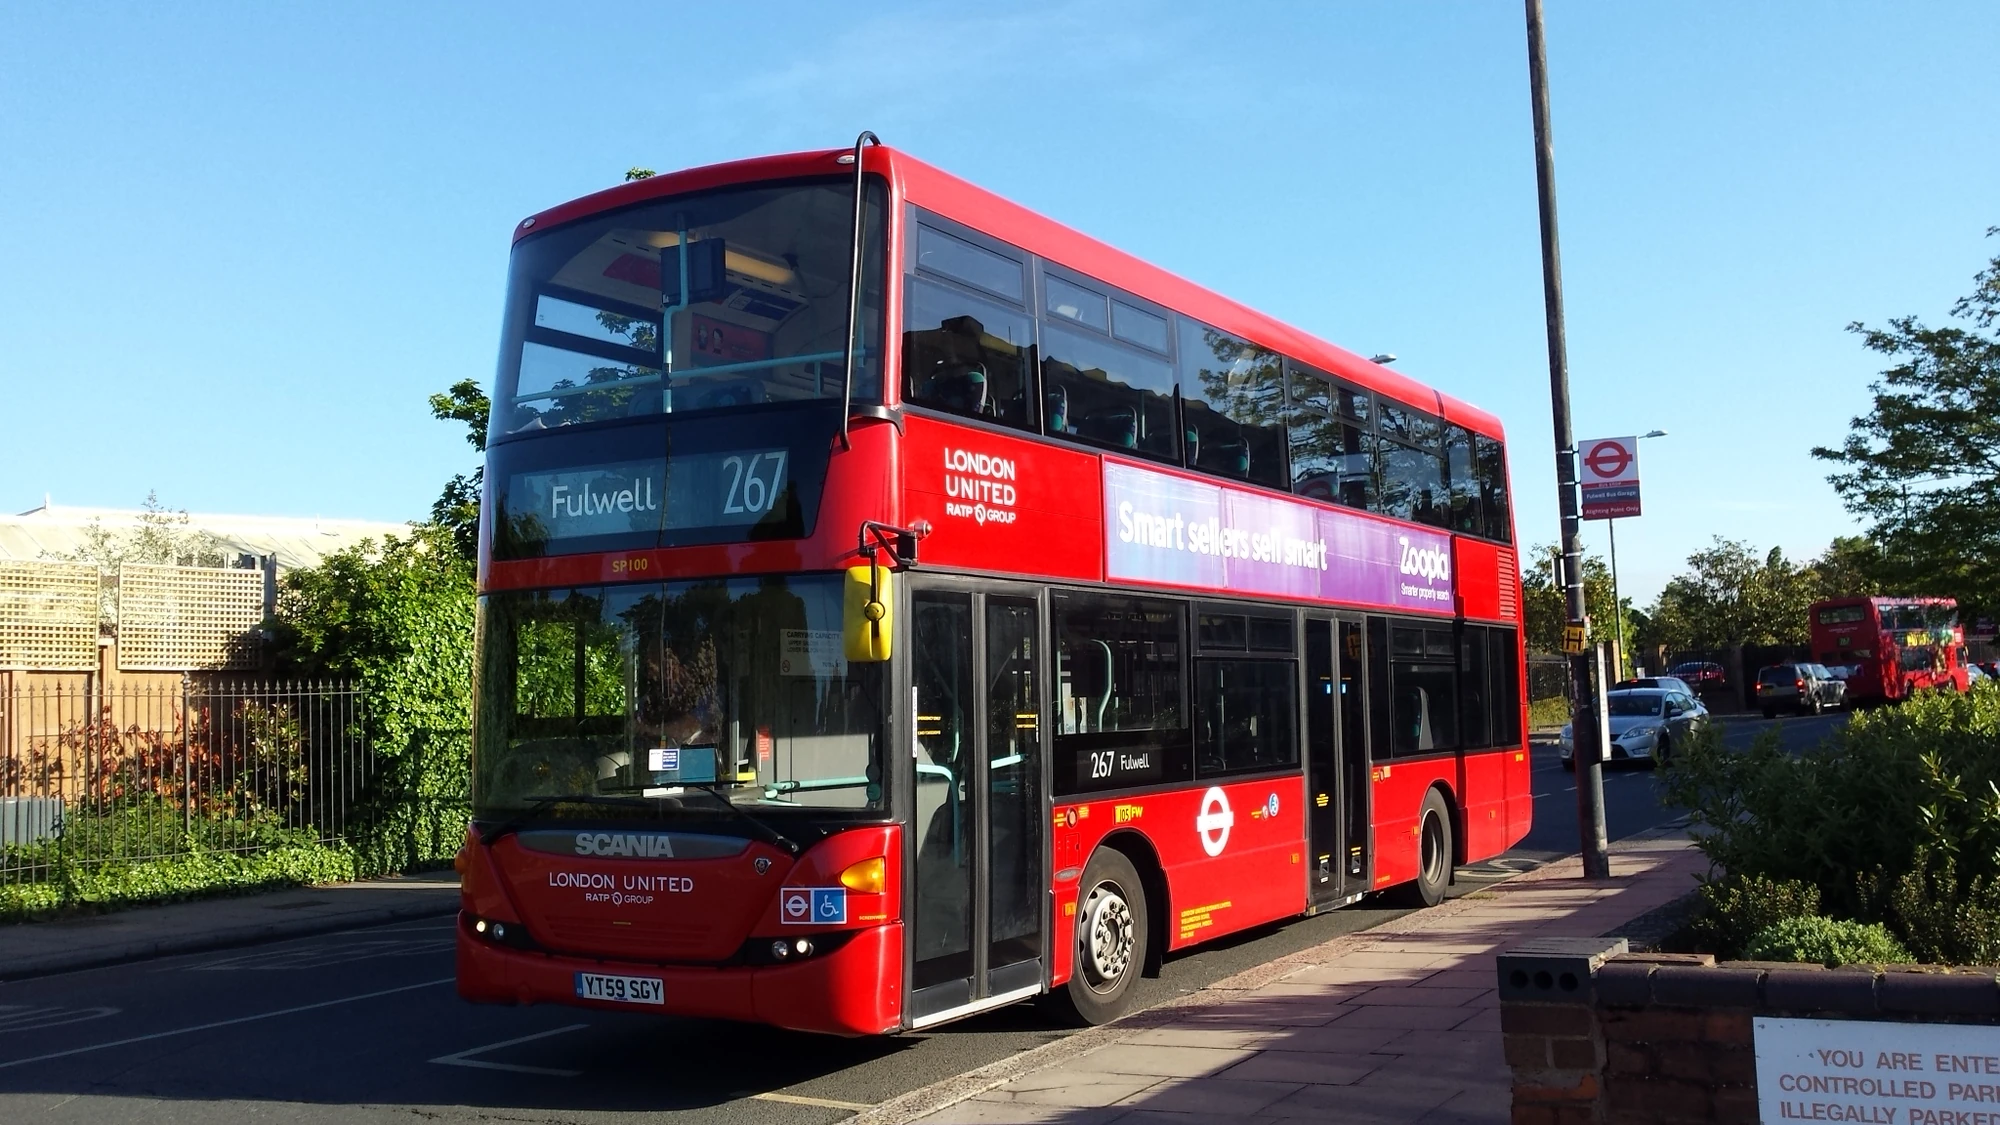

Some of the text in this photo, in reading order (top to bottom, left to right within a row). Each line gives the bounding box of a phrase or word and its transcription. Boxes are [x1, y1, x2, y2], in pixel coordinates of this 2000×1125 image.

[944, 447, 1015, 481] LONDON
[723, 451, 787, 514] 267
[945, 474, 1016, 506] UNITED
[552, 477, 656, 519] Fulwell
[946, 502, 1016, 524] RATP GROUP
[1119, 500, 1328, 571] Smart sellers sell smart
[612, 558, 648, 573] SP100
[1399, 536, 1449, 586] Zoopla
[1401, 582, 1450, 602] Smarter property search
[786, 631, 814, 639] CARRYING
[1091, 751, 1150, 778] 267 Fulwell
[1119, 806, 1143, 821] 105 FW
[575, 833, 674, 858] SCANIA
[549, 872, 694, 893] LONDON UNITED
[585, 892, 654, 904] RATP GROUP
[585, 976, 661, 1000] YT59 SGY
[1817, 1049, 2000, 1074] YOU ARE ENTE
[1779, 1073, 1937, 1100] CONTROLLED
[1780, 1101, 1897, 1125] ILLEGALLY
